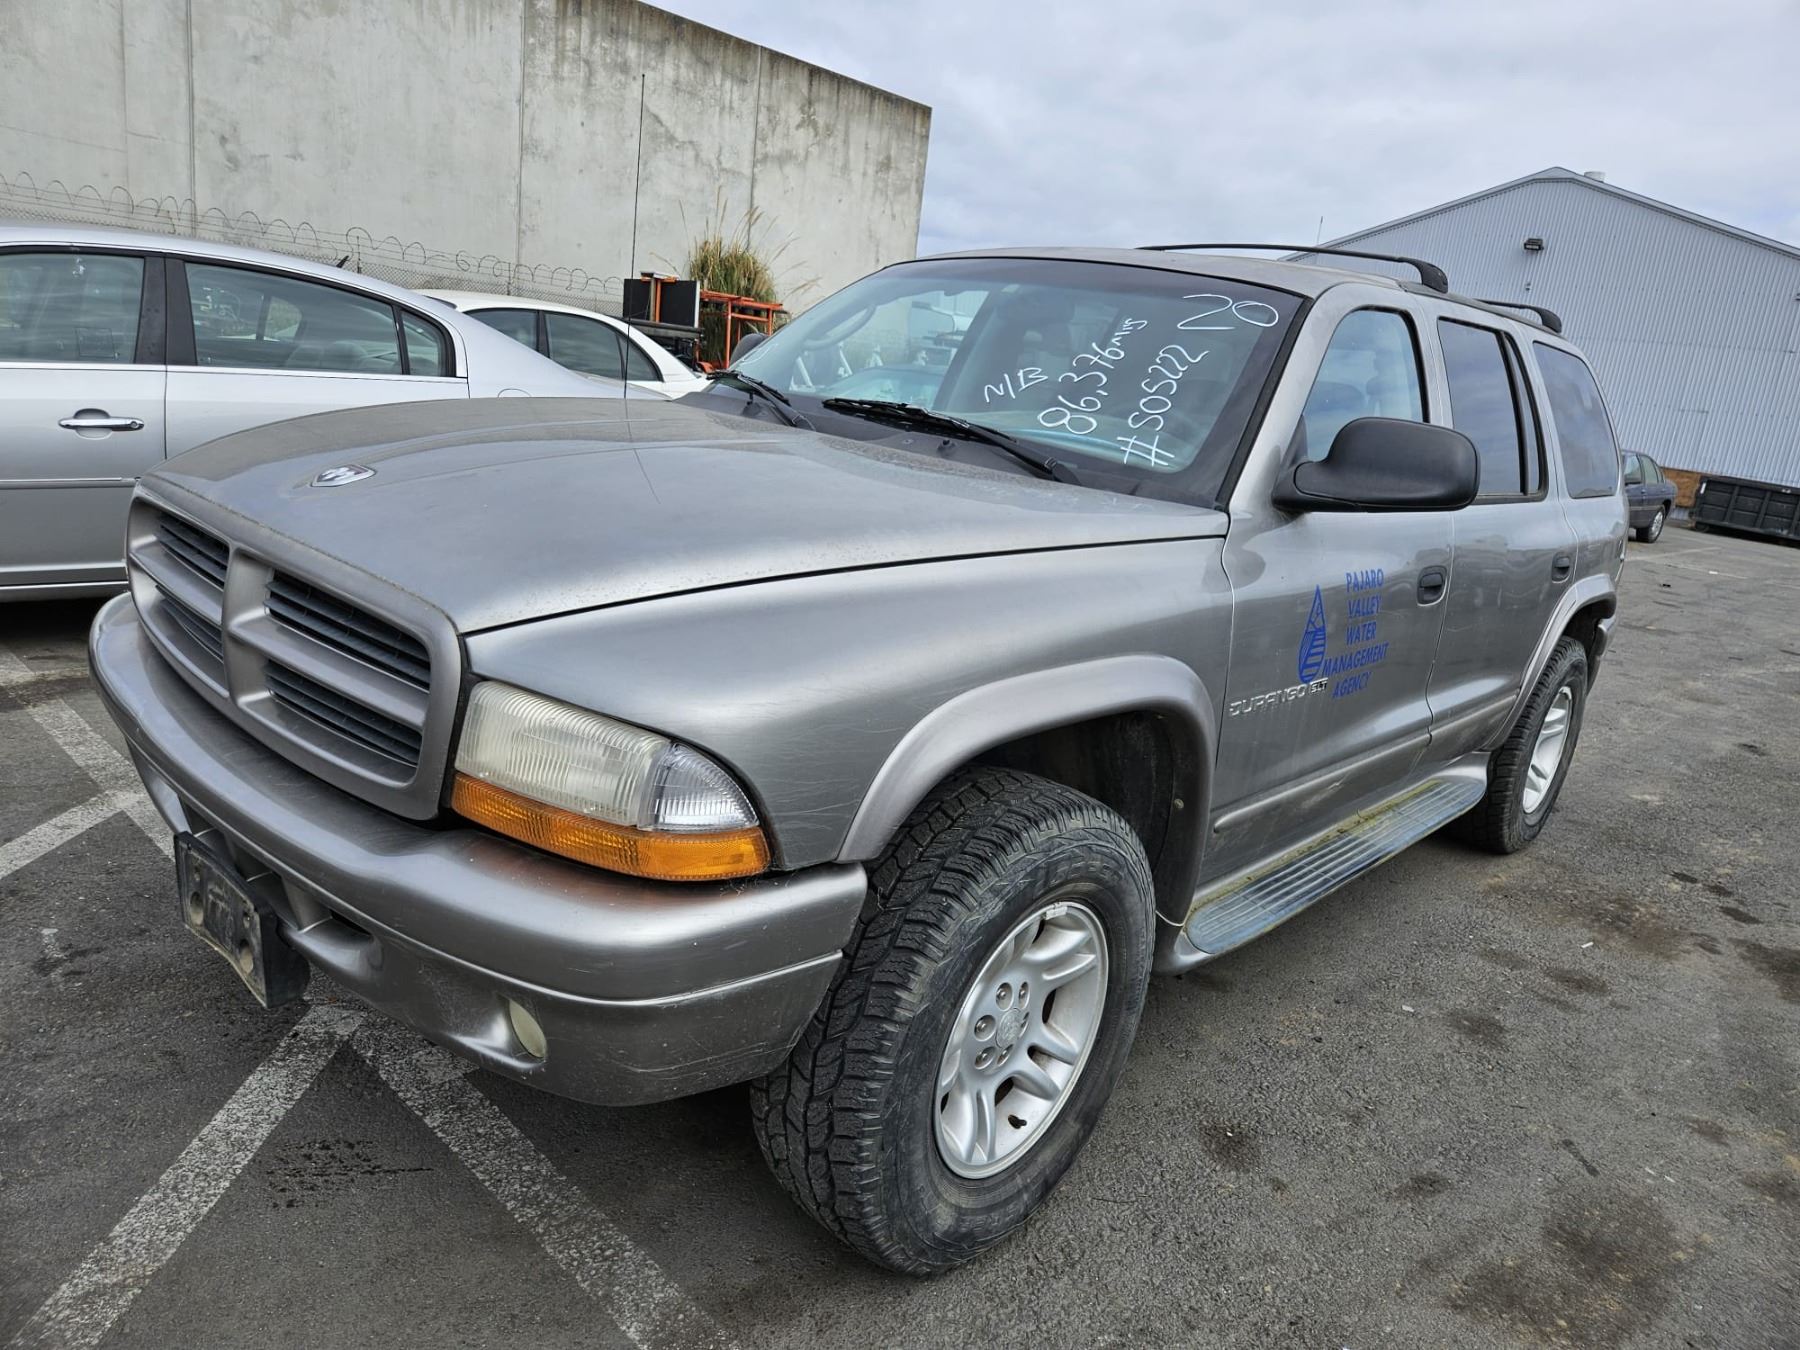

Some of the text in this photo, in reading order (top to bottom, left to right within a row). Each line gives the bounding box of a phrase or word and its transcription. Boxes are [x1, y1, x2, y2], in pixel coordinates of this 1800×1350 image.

[1177, 294, 1279, 329] 20
[1346, 569, 1384, 592] PAJARO
[1348, 597, 1381, 619] VALLEY
[1346, 622, 1376, 645] WATER
[1322, 643, 1389, 677] MANAGEMENT
[1310, 678, 1329, 693] SLT
[1332, 672, 1371, 698] AGENCY
